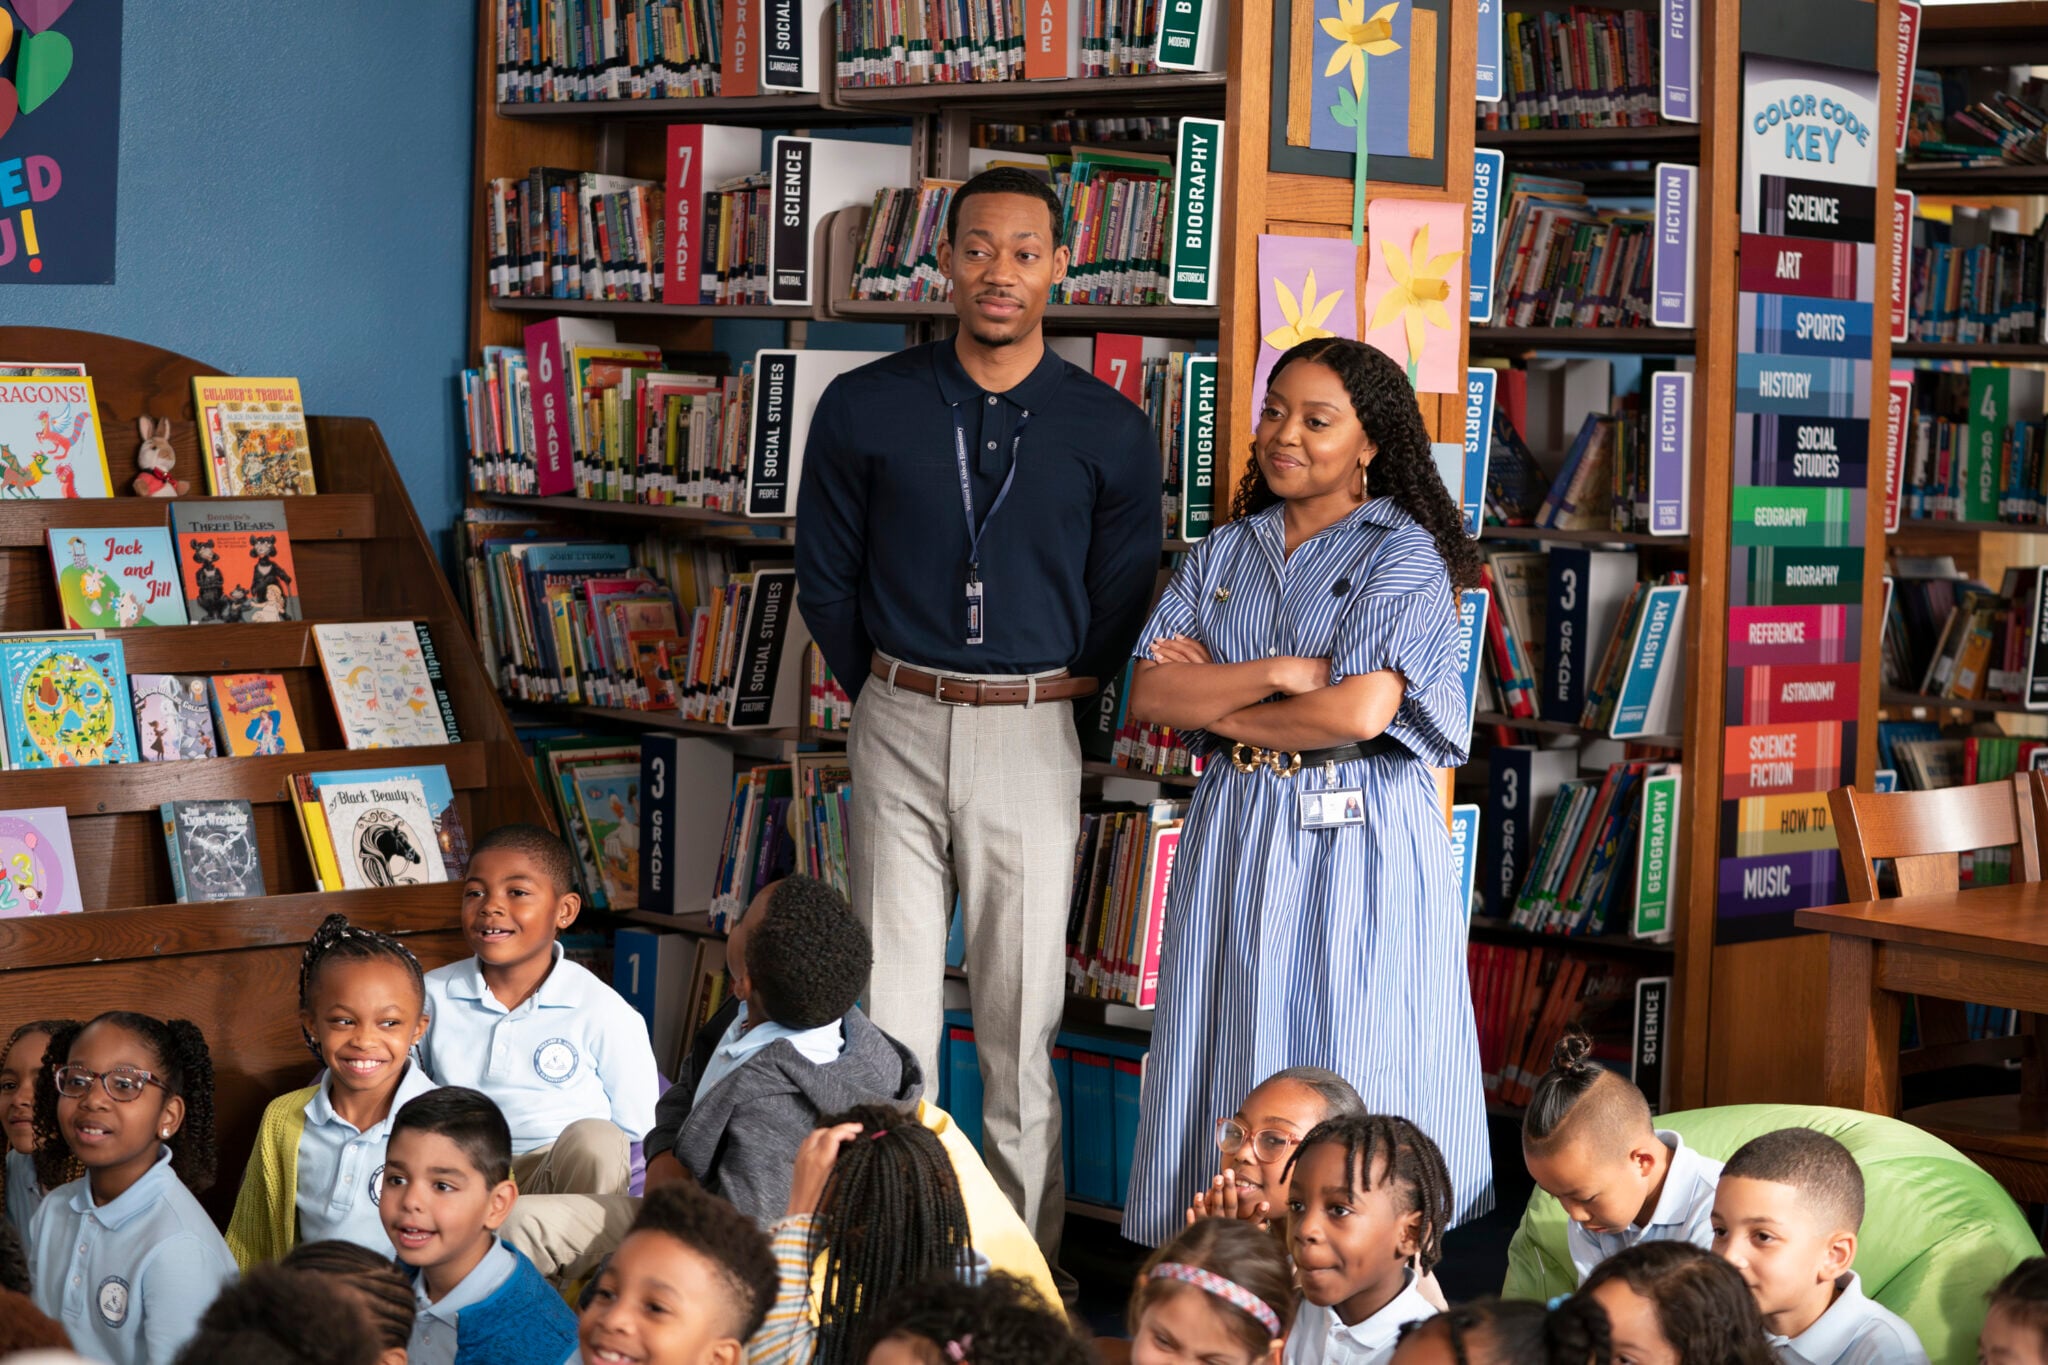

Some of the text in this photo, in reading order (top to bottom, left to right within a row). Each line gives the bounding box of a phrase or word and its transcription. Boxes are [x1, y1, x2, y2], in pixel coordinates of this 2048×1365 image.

[776, 0, 791, 51] SOCIAL
[1671, 0, 1685, 39] FICT
[1167, 36, 1192, 49] MODERN
[769, 61, 799, 73] LANGUAGE
[1753, 94, 1871, 147] COLOR CODE
[1785, 122, 1842, 163] KEY
[678, 146, 693, 188] 7
[785, 149, 802, 227] SCIENCE
[1185, 133, 1209, 249] BIOGRAPHY
[1472, 163, 1491, 235] SPORTS
[1665, 175, 1682, 245] FICTION
[1787, 194, 1840, 224] SCIENCE
[676, 200, 689, 282] GRADE
[779, 275, 802, 287] NATURAL
[1176, 271, 1206, 284] HISTORICAL
[1775, 251, 1803, 280] ART
[1797, 312, 1845, 342] SPORTS
[538, 342, 552, 383] 6
[1111, 358, 1127, 393] 7
[255, 387, 295, 402] TRAVELS
[1759, 371, 1811, 399] HISTORY
[1980, 384, 1998, 423] 4
[544, 393, 561, 472] GRADE
[763, 362, 785, 478] SOCIAL STUDIES
[1196, 372, 1215, 487] BIOGRAPHY
[1465, 381, 1484, 453] SPORTS
[1661, 383, 1677, 453] FICTION
[1797, 426, 1837, 451] SOCIAL
[1793, 453, 1840, 478] STUDIES
[1980, 431, 1994, 504] GRADE
[758, 488, 779, 499] PEOPLE
[188, 520, 276, 532] THREE BEARS
[1754, 507, 1808, 527] GEOGRAPHY
[104, 537, 143, 562] Jack
[124, 561, 154, 579] and
[146, 580, 172, 604] Jill
[1561, 568, 1577, 611] 3
[1786, 565, 1839, 587] BIOGRAPHY
[415, 624, 443, 679] Alphabet
[751, 581, 783, 692] SOCIAL STUDIES
[1460, 602, 1476, 673] SPORTS
[1640, 600, 1670, 669] HISTORY
[1749, 622, 1805, 644] REFERENCE
[14, 666, 31, 705] TREASURE
[29, 646, 52, 667] ISLAND
[1557, 620, 1574, 701] GRADE
[740, 702, 766, 713] CULTURE
[1781, 681, 1835, 703] ASTRONOMY
[1749, 733, 1797, 760] SCIENCE
[651, 757, 666, 800] 3
[1502, 768, 1518, 809] 3
[1750, 762, 1794, 788] FICTION
[337, 788, 410, 805] Black Beauty
[1780, 807, 1826, 835] HOW TO
[651, 810, 664, 891] GRADE
[1451, 819, 1467, 888] SPOR
[1501, 820, 1515, 898] GRADE
[1647, 790, 1668, 894] GEOGRAPHY
[11, 853, 35, 886] 3
[1743, 864, 1792, 900] MUSIC
[628, 952, 641, 994] 1
[1643, 990, 1660, 1066] SCIENCE
